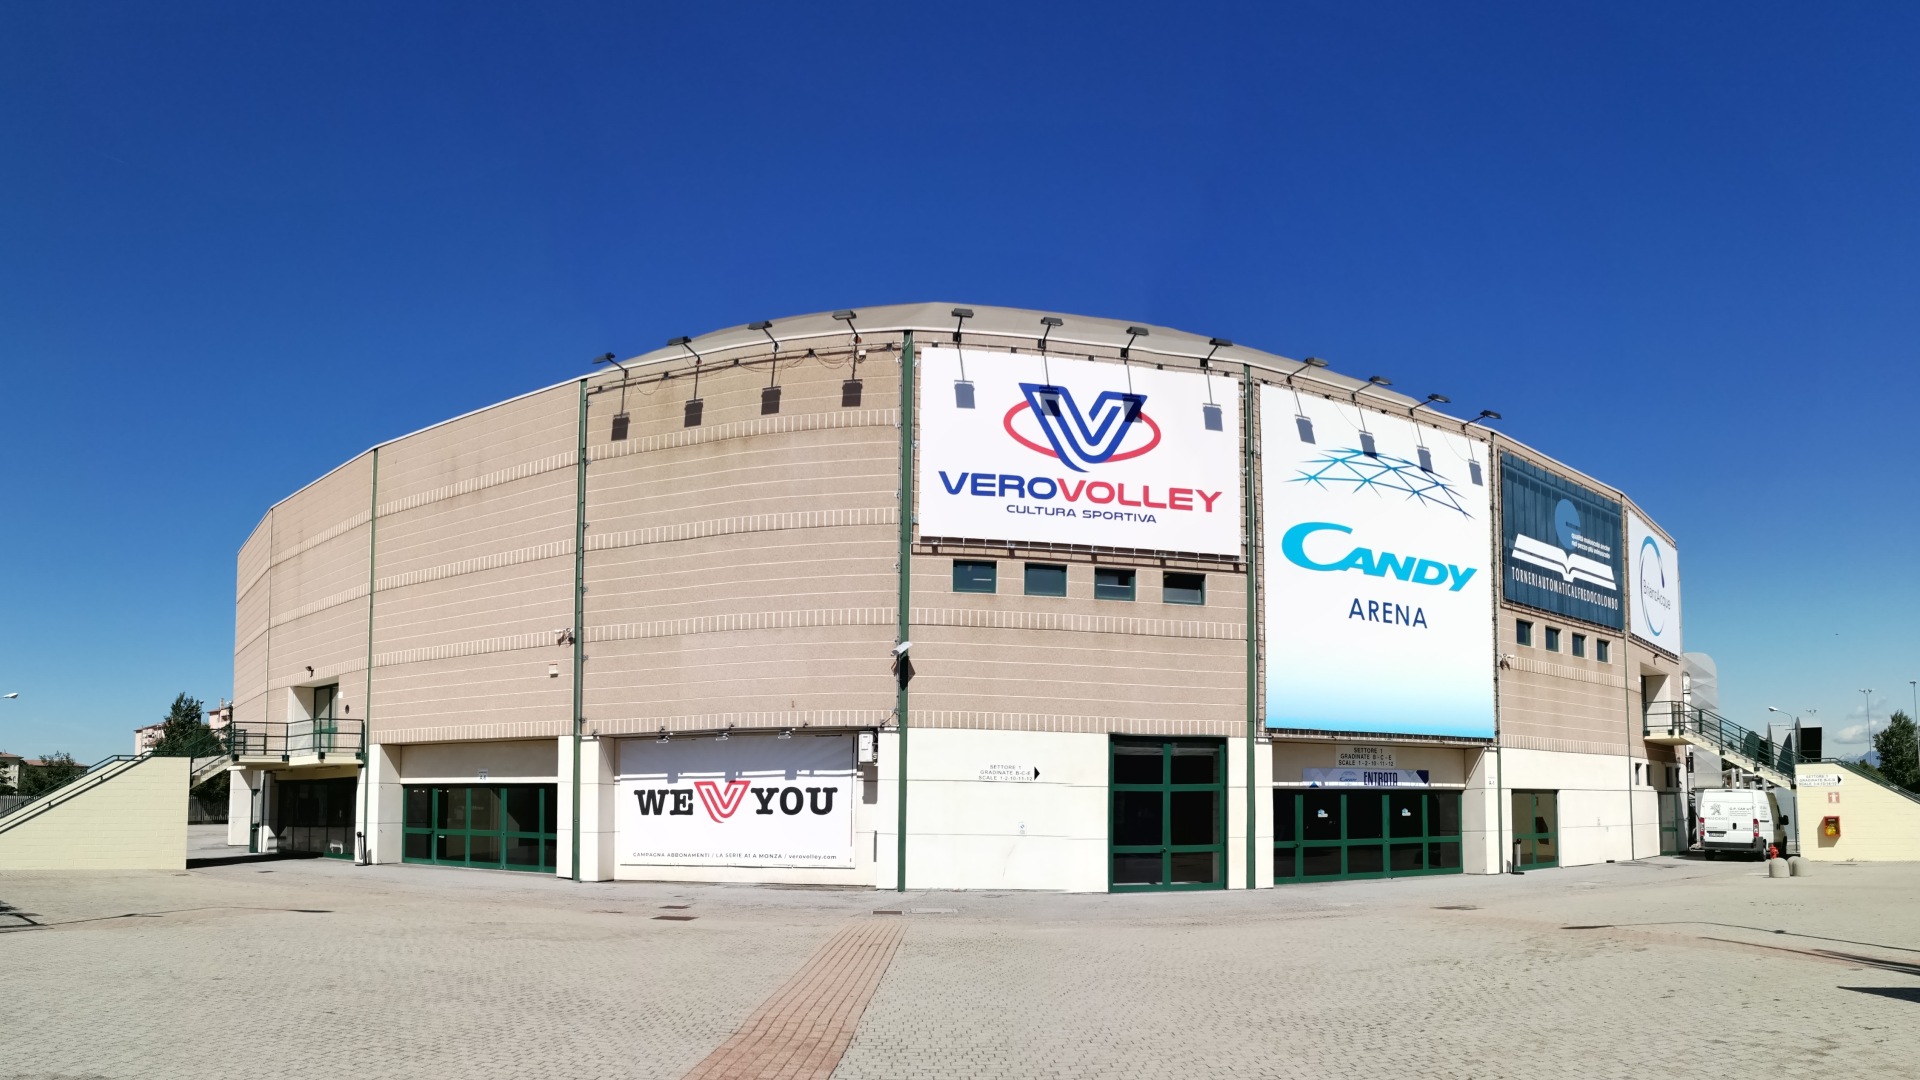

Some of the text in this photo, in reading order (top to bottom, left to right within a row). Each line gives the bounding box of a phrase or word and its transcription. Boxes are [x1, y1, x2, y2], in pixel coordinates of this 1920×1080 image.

[938, 470, 1223, 513] VEROVOLLEY
[1006, 504, 1157, 524] CULTURA SPORTIVA
[1348, 597, 1428, 629] ARENA
[1363, 771, 1398, 787] ENTRATA
[633, 788, 694, 816] WE
[750, 786, 839, 816] YOU
